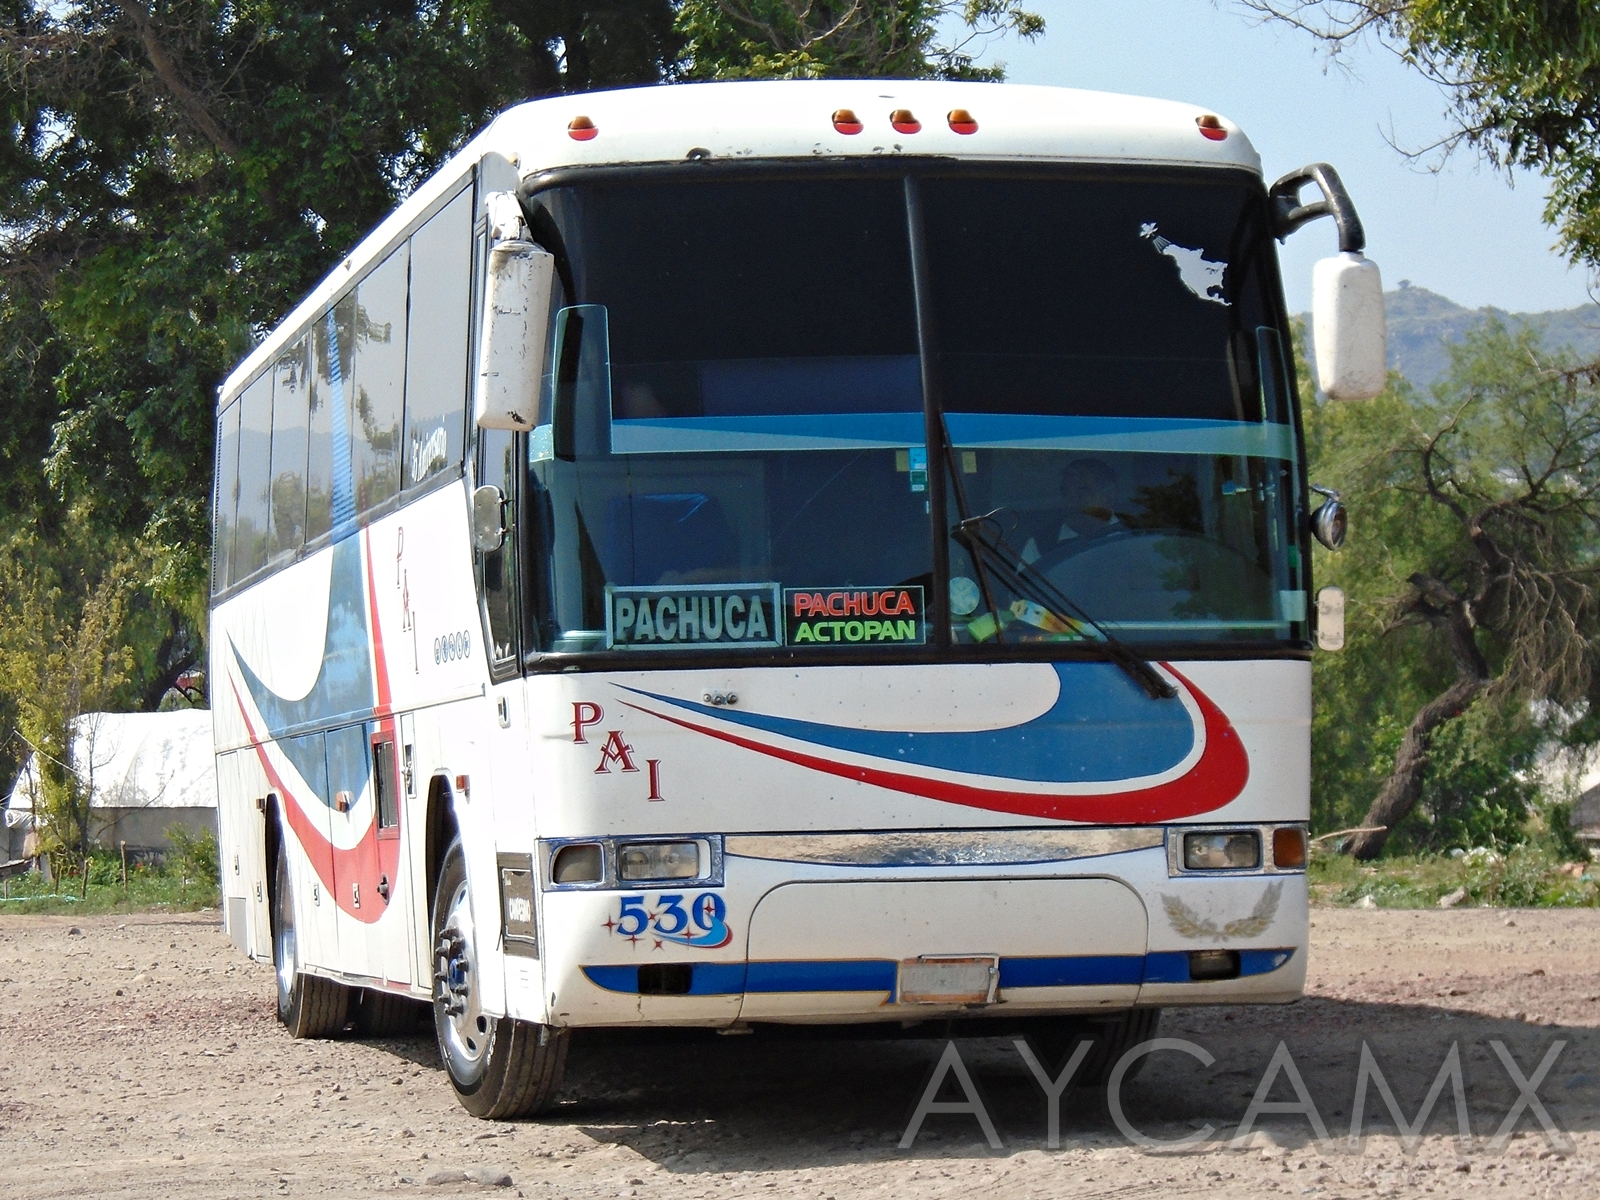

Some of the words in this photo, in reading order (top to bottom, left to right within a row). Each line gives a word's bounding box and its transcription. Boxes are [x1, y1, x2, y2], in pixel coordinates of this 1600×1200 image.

[615, 594, 769, 642] PACHUCA
[794, 591, 916, 617] PACHUCA
[795, 620, 917, 643] ACTOPAN
[616, 892, 727, 936] 530
